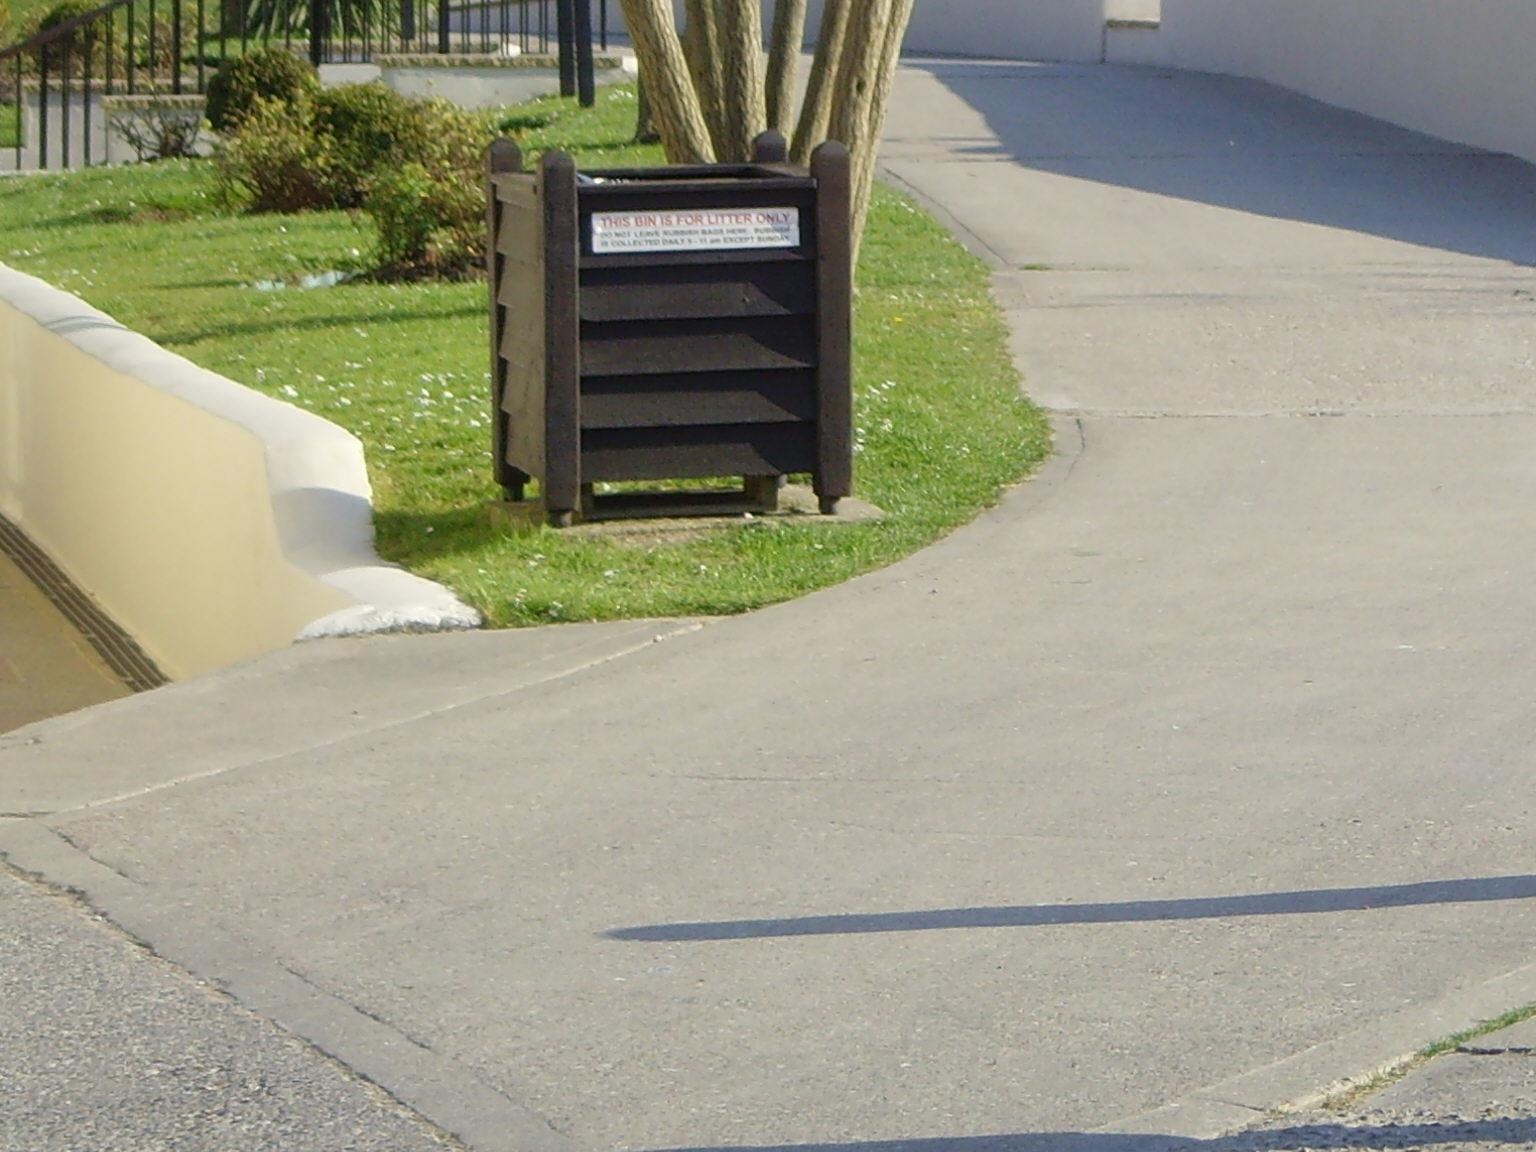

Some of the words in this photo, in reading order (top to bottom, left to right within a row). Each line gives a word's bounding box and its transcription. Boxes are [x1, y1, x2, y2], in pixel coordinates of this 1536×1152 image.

[601, 216, 630, 227] THIS
[635, 215, 656, 226] BIN
[661, 215, 673, 226] IS
[677, 214, 704, 225] FOR
[708, 213, 752, 224] LITTER
[757, 212, 790, 223] ONLY
[611, 239, 660, 247] COLLECTED
[662, 238, 684, 246] DAILY
